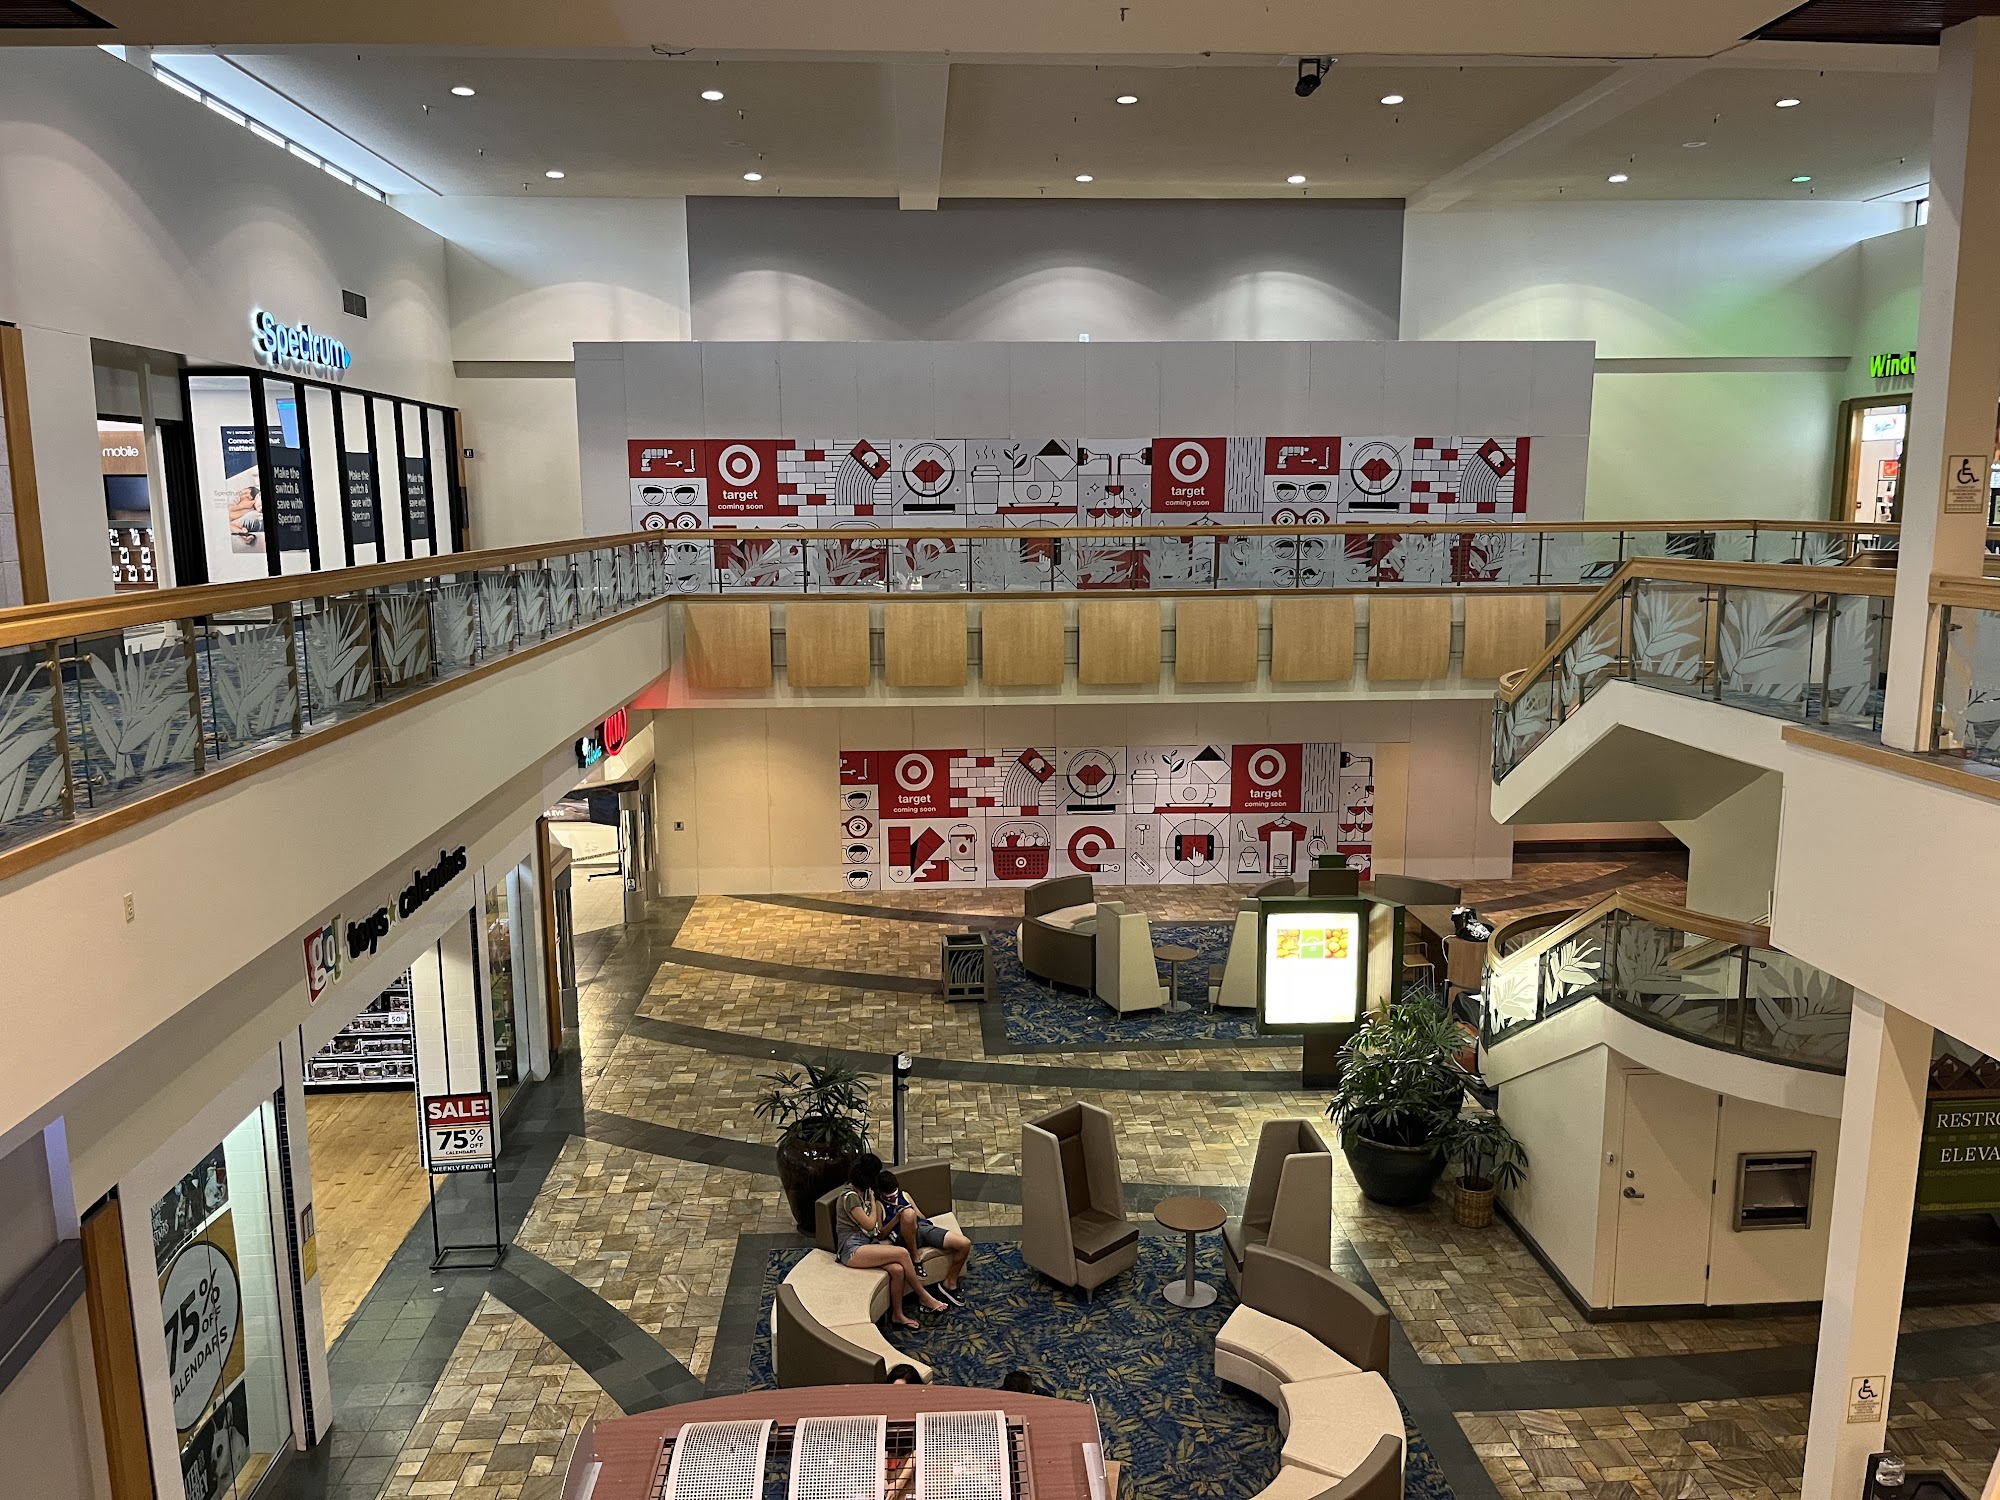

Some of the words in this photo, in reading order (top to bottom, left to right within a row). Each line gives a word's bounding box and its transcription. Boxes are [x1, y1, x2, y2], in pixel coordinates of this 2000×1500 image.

[257, 311, 347, 369] Spectrum
[102, 446, 139, 457] mobile
[274, 467, 290, 479] Make
[290, 467, 300, 479] the
[349, 470, 361, 480] Make
[361, 470, 369, 480] the
[275, 483, 294, 494] switch
[350, 484, 364, 494] switch
[1171, 486, 1205, 498] target
[723, 490, 758, 501] target
[277, 499, 290, 510] save
[291, 498, 303, 510] with
[718, 503, 744, 511] coming
[1165, 499, 1191, 507] coming
[278, 514, 301, 525] Spectrum
[352, 512, 370, 522] Spectrum
[898, 794, 931, 805] target
[1250, 789, 1282, 800] target
[347, 908, 389, 958] toys
[399, 846, 466, 919] calendars
[428, 1099, 489, 1119] SALE!
[202, 1306, 221, 1333] OFF
[172, 1326, 228, 1404] ALENDARS
